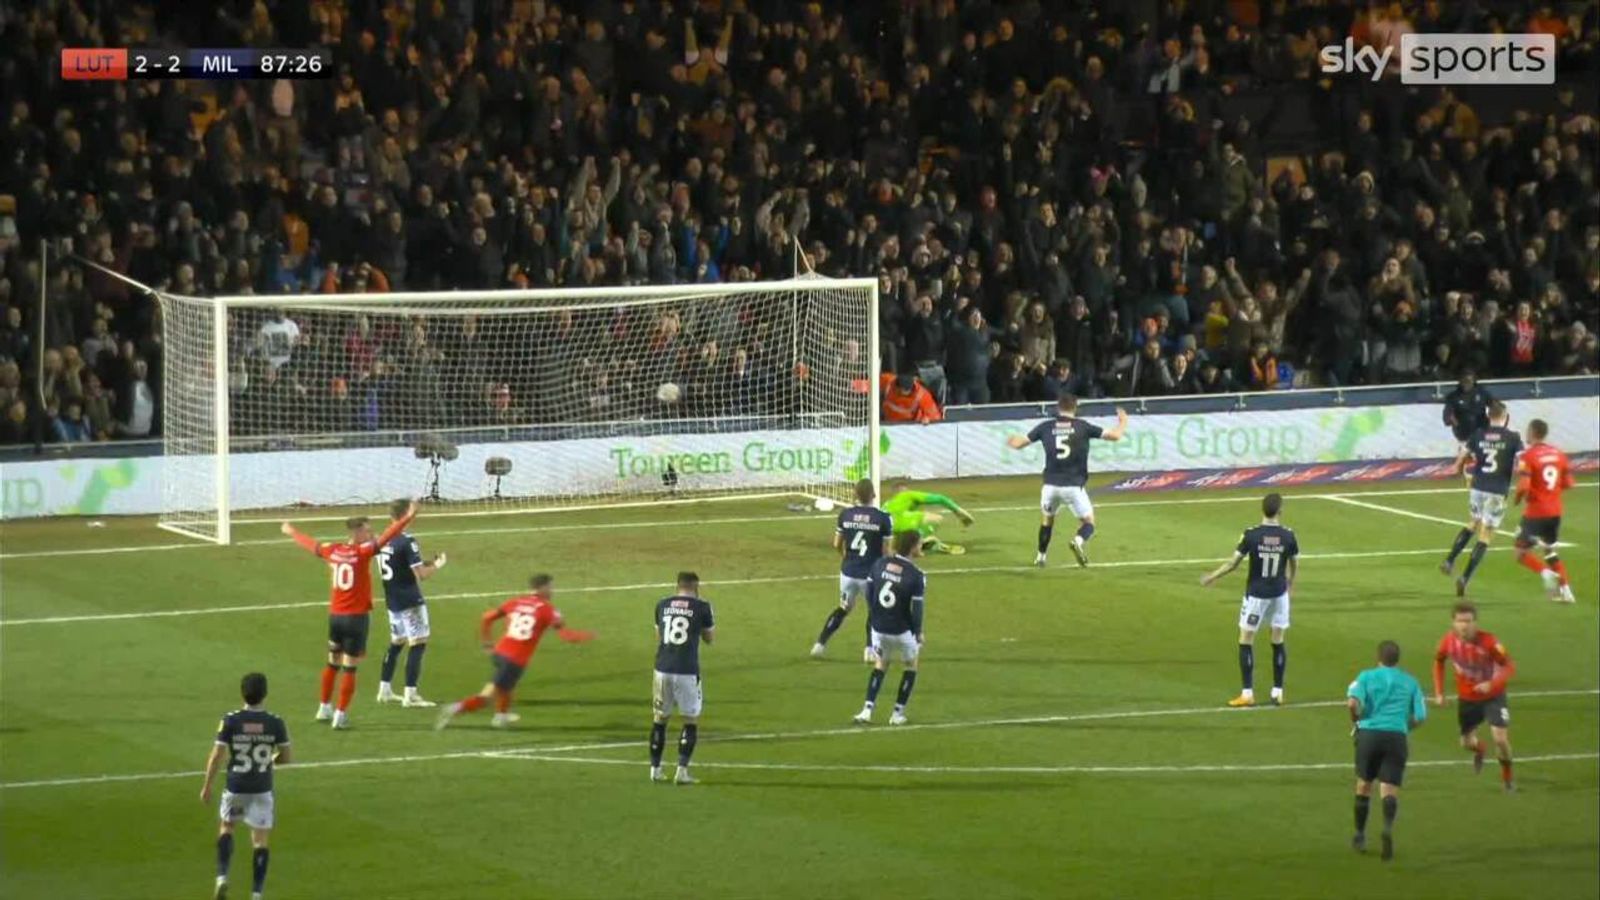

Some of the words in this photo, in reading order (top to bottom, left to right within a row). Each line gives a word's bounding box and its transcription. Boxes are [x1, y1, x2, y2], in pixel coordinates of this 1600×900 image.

[1055, 435, 1071, 459] 5
[1176, 415, 1301, 463] Group
[609, 446, 733, 479] Toureen
[742, 442, 834, 475] Group
[1481, 448, 1498, 473] 3
[1542, 465, 1559, 490] 9
[850, 531, 868, 556] 4
[330, 562, 354, 590] 10
[1258, 552, 1280, 577] 11
[878, 580, 896, 608] 6
[509, 611, 536, 640] 18
[662, 615, 689, 645] 18
[232, 743, 273, 773] 39
